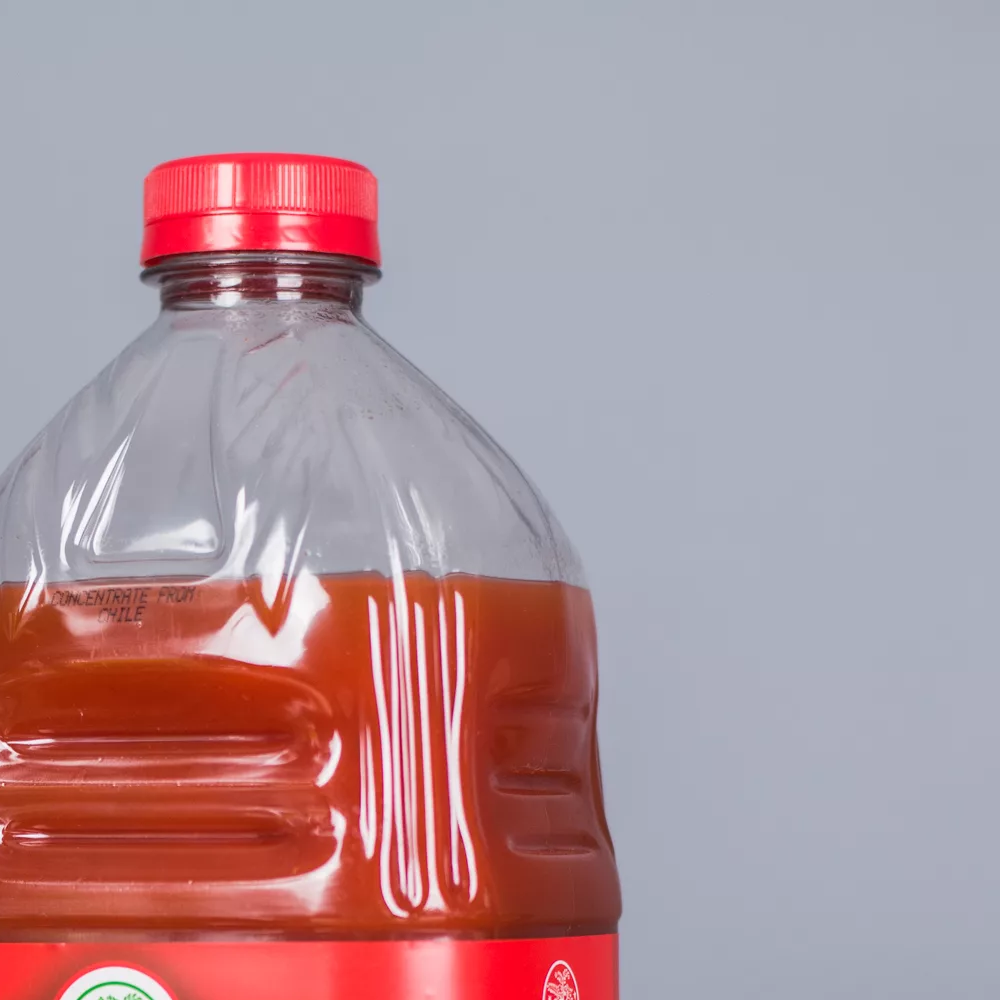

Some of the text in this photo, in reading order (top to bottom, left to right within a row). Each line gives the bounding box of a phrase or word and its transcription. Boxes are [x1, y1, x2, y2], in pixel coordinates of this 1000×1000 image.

[51, 586, 196, 606] CONCENTRATE FROM
[98, 606, 145, 622] CHILE
